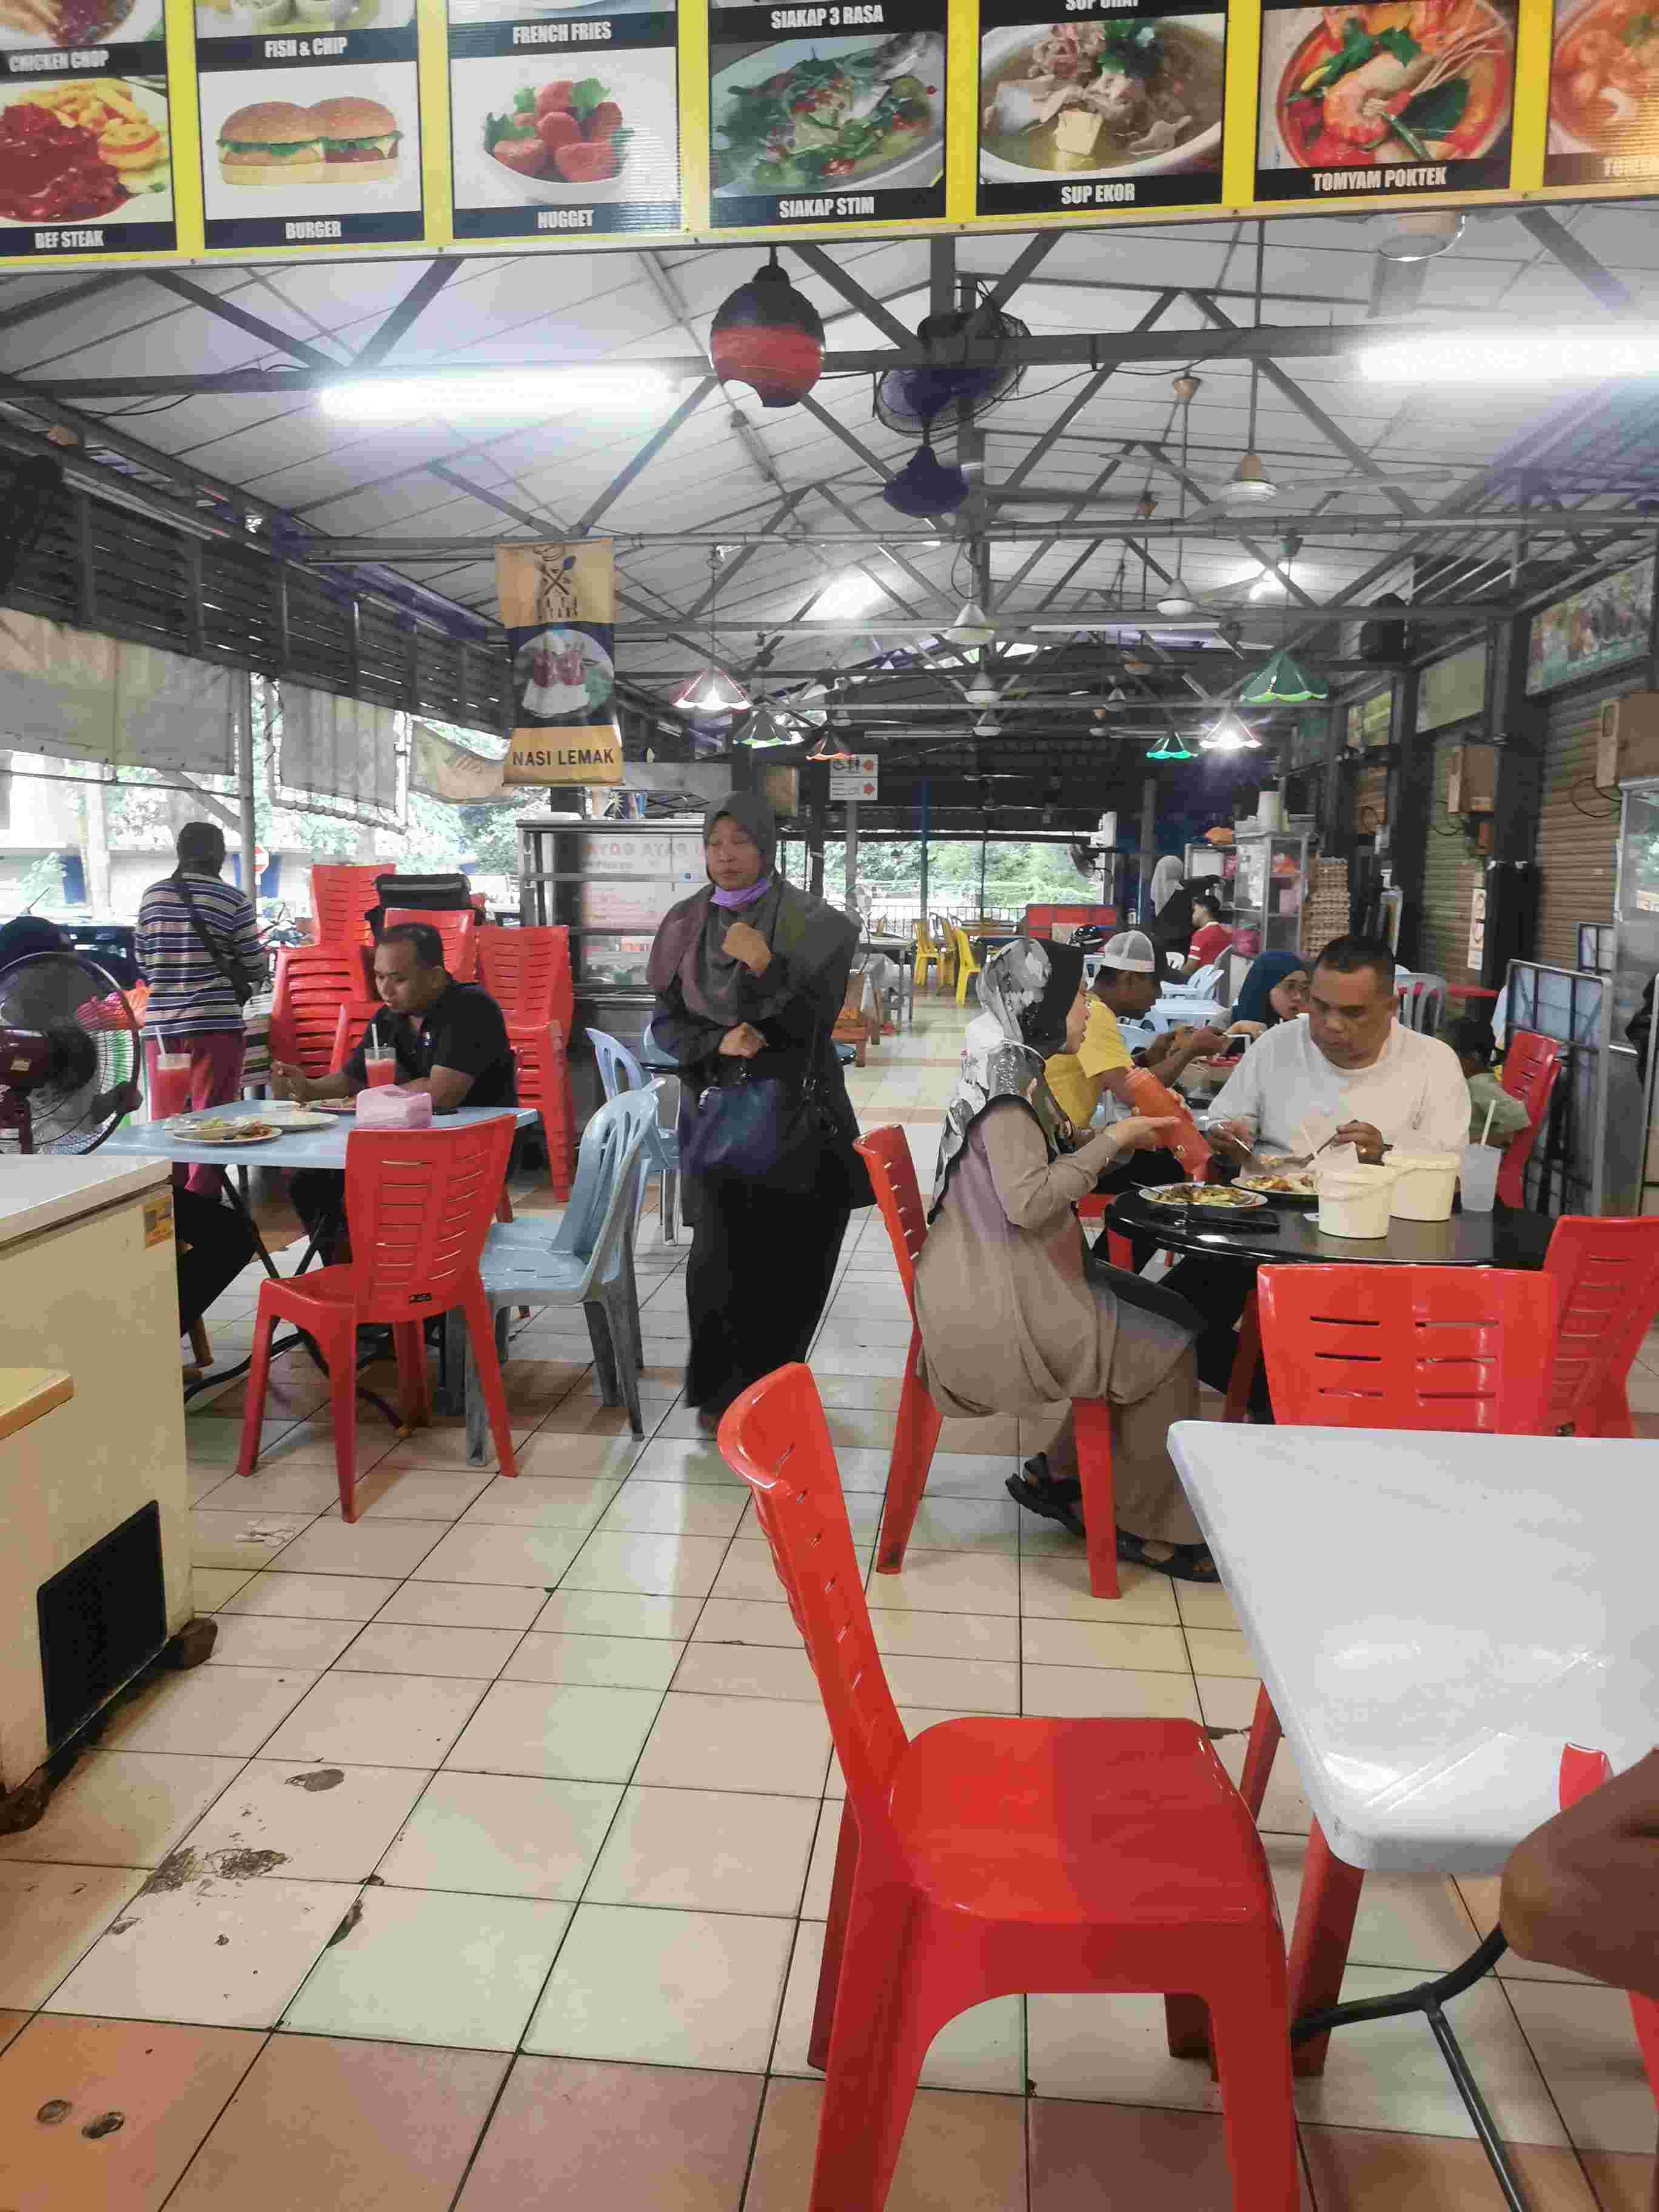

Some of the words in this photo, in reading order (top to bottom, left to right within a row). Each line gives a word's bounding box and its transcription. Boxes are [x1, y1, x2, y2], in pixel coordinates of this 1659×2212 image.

[771, 8, 827, 28] SIAKAP
[830, 7, 840, 25] 3
[842, 4, 883, 24] RASA
[513, 24, 569, 44] FRENCH
[571, 22, 612, 41] FRIES
[265, 39, 297, 58] FISH
[300, 41, 311, 56] &
[313, 36, 347, 56] CHIP
[9, 53, 70, 72] CHICKEN
[71, 50, 109, 68] CHOP
[1313, 170, 1382, 191] TOMYAM
[1385, 166, 1447, 187] POKTEK
[1061, 185, 1093, 204] SUP
[1096, 183, 1135, 203] EKOR
[780, 198, 834, 218] SIAKAP
[836, 196, 875, 216] STIM
[286, 221, 341, 239] BURGER
[538, 210, 594, 229] NUGGET
[61, 230, 104, 247] STEAK
[513, 751, 551, 766] NASI
[558, 748, 614, 765] LEMAK
